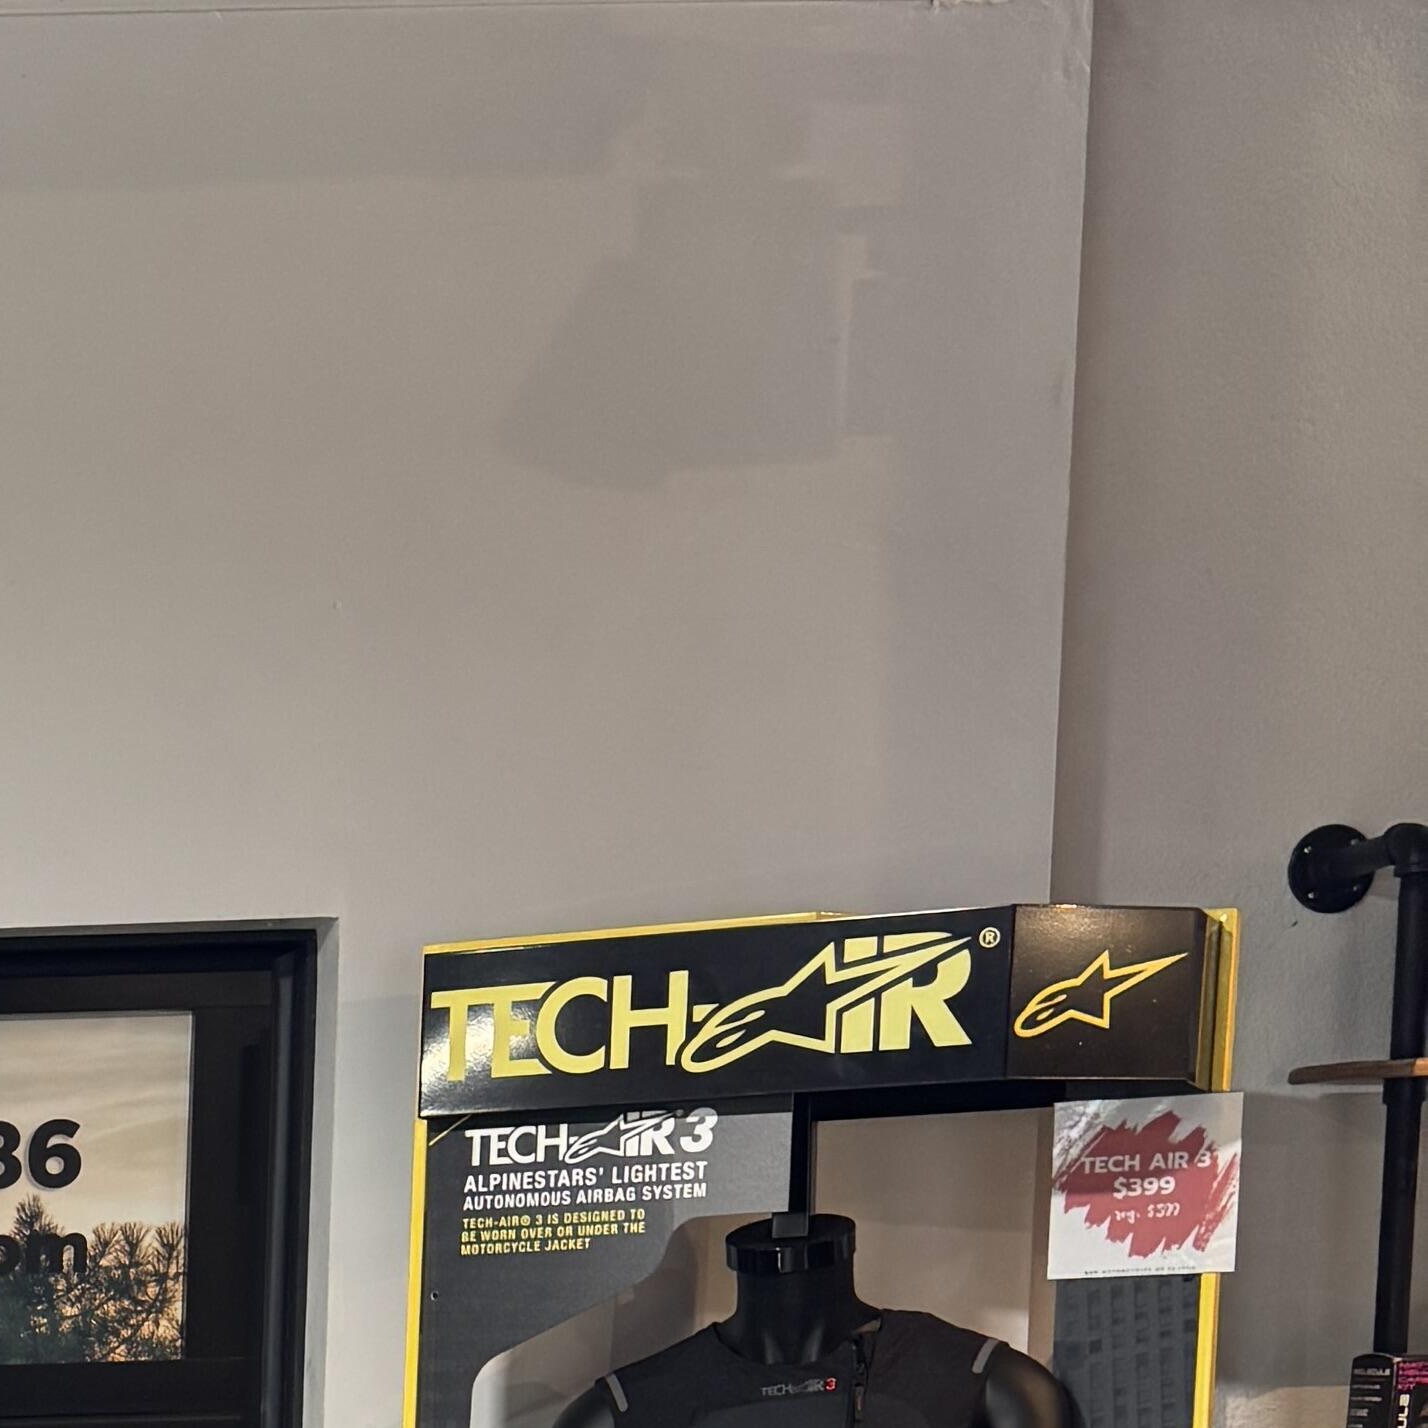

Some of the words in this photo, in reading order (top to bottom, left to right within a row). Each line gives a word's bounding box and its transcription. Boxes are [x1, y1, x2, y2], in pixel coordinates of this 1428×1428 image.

[679, 1106, 719, 1153] 3
[611, 1161, 708, 1186] LIGHTEST
[1083, 1154, 1140, 1174] TECH
[1149, 1152, 1188, 1171] AIR
[1197, 1151, 1211, 1168] 3
[463, 1191, 571, 1211] AUTONOMOUS
[576, 1186, 635, 1204] AIRBAG
[642, 1182, 707, 1201] SYSTEM
[1112, 1176, 1176, 1200] $399
[548, 1212, 559, 1225] IS
[563, 1210, 625, 1224] DESIGNED
[630, 1208, 646, 1220] TO
[461, 1230, 477, 1243] BE
[480, 1228, 516, 1242] WORN
[521, 1226, 552, 1239] OVER
[557, 1225, 573, 1238] OR
[578, 1223, 618, 1237] UNDER
[623, 1221, 646, 1234] THE
[460, 1240, 541, 1256] MOTORCYCLE
[544, 1238, 591, 1252] JACKET
[825, 1377, 837, 1391] 3
